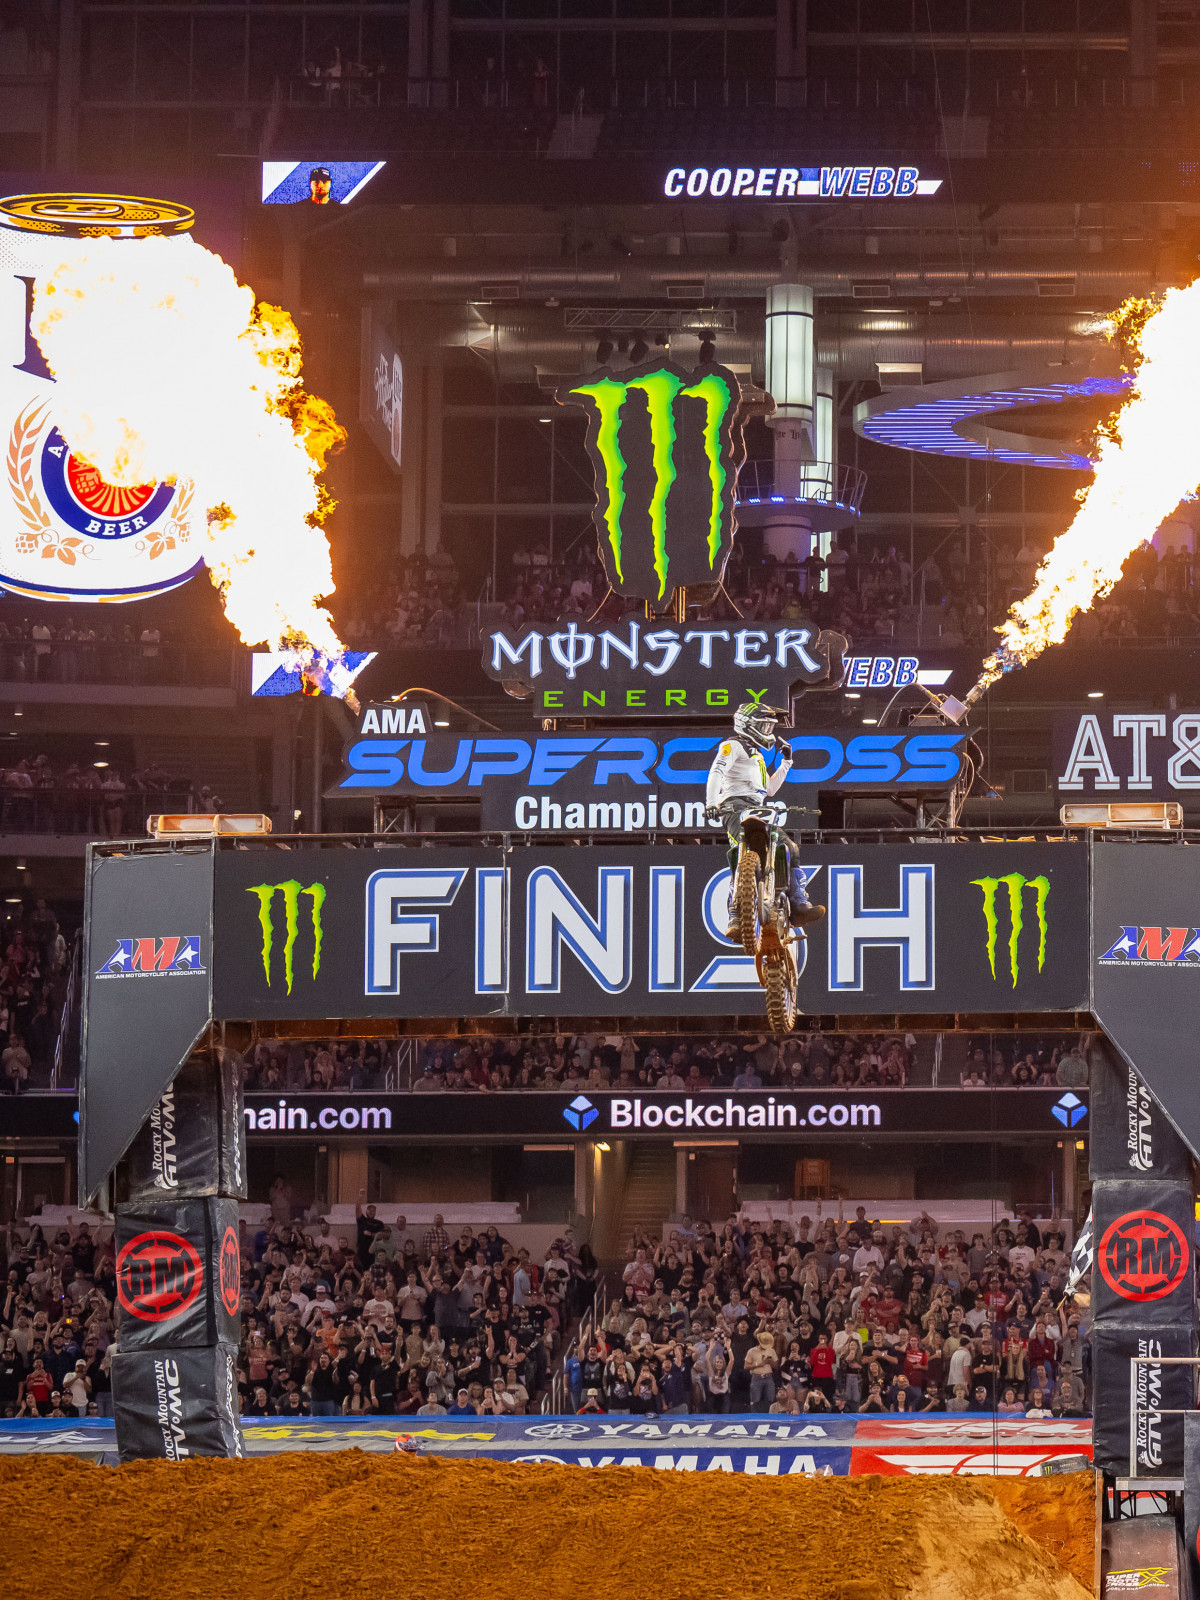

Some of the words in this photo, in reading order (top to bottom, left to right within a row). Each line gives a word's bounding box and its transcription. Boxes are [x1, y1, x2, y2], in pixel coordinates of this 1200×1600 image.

[664, 168, 799, 197] COOPER
[820, 166, 919, 197] WEBB
[85, 516, 148, 537] BEER
[489, 621, 821, 680] MONSTER
[543, 688, 769, 708] ENERGY
[361, 709, 427, 734] AMA
[339, 734, 966, 787] SUPERCOSS
[515, 795, 787, 831] Championp
[365, 863, 936, 996] FINISH
[95, 936, 206, 973] AMA
[610, 1097, 881, 1127] Blockchain.com
[1127, 1108, 1138, 1150] ROCKY
[152, 1132, 163, 1171] ROCKY
[1114, 1237, 1172, 1275] RM
[130, 1256, 188, 1297] RM
[154, 1360, 169, 1426] MOUNTAIN
[598, 1423, 828, 1438] YAMAHA
[1137, 1408, 1147, 1448] ROCKY
